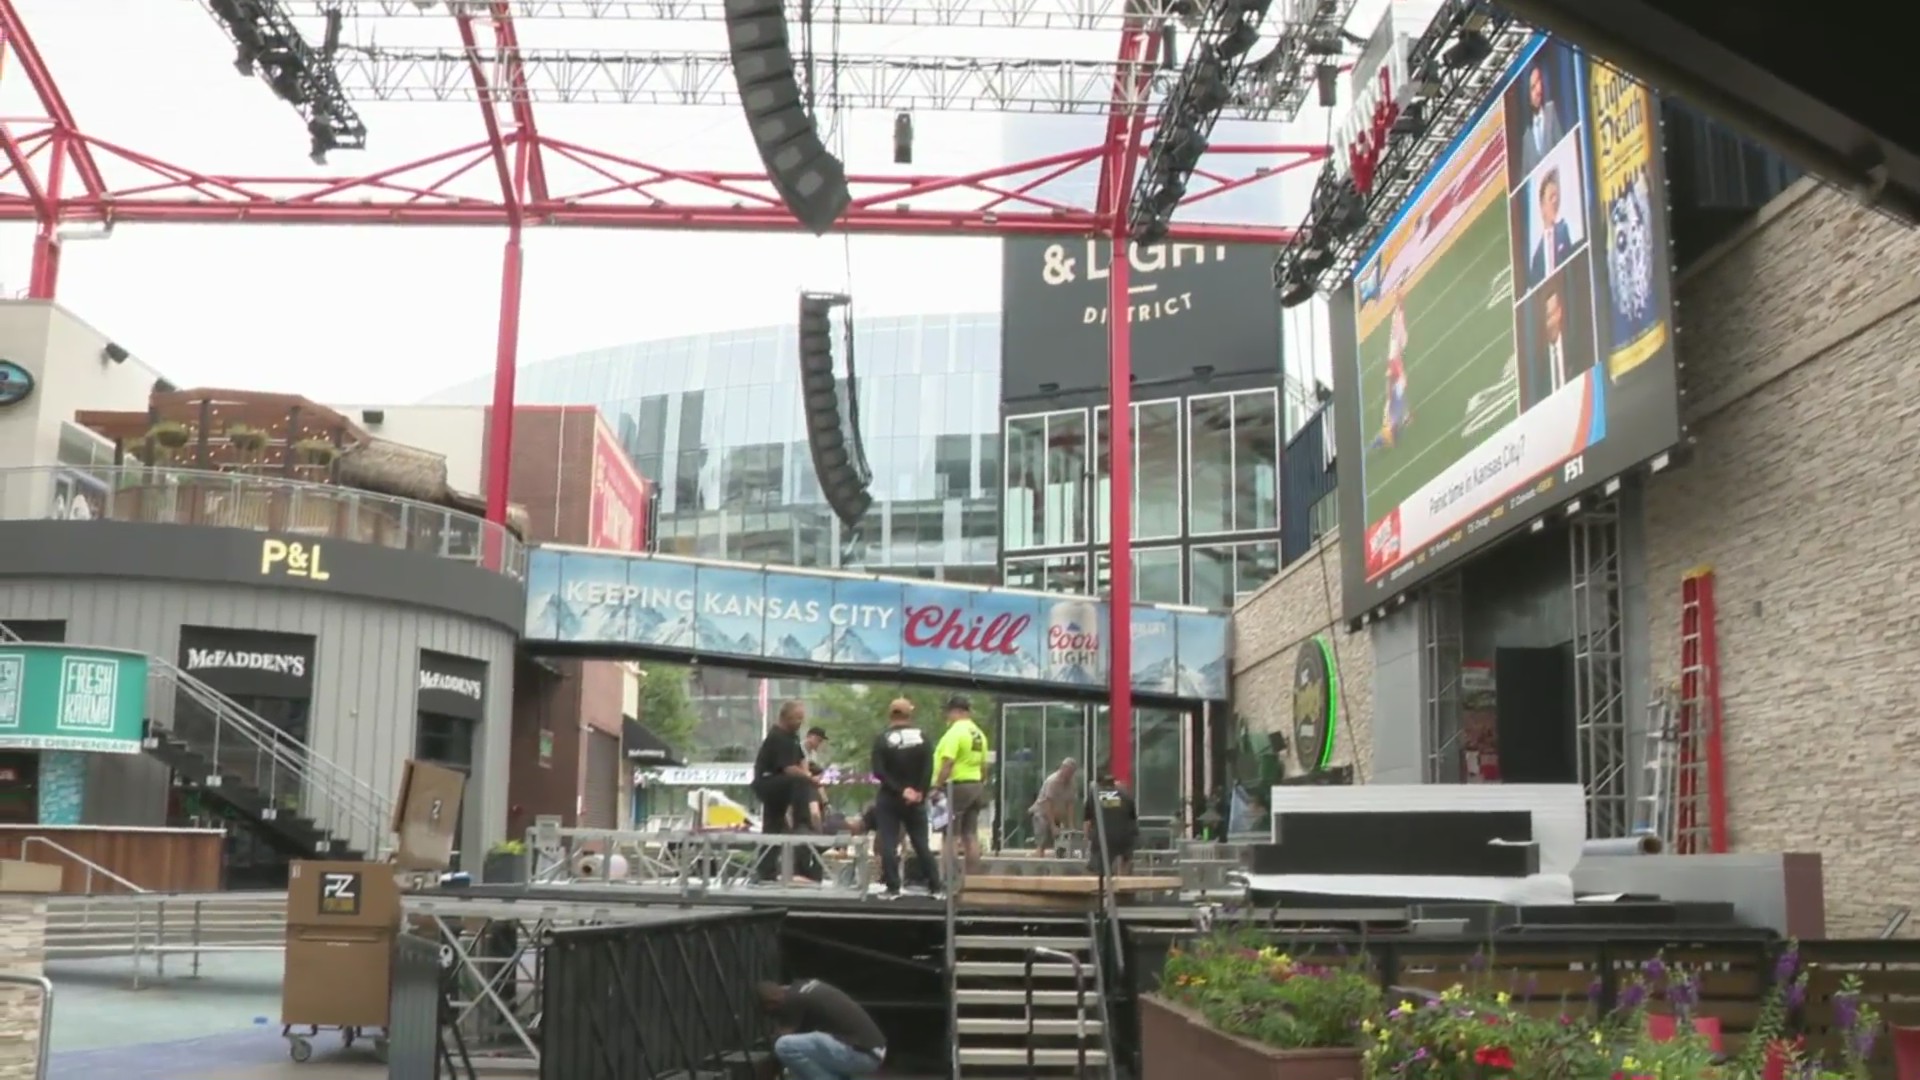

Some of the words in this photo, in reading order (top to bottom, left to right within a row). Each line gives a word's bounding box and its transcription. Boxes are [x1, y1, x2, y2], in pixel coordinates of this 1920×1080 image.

[1599, 100, 1643, 156] Death
[1042, 243, 1076, 286] &
[1083, 291, 1193, 325] DITRICT
[1473, 453, 1502, 490] Kansas
[1564, 455, 1584, 483] FS1
[261, 538, 330, 581] P&L
[566, 579, 693, 612] KEEPING
[704, 592, 820, 624] KANSAS
[829, 602, 894, 630] CITY
[904, 604, 1031, 656] Chill
[1048, 624, 1100, 652] Coors
[1050, 650, 1098, 666] LIGHT
[66, 662, 114, 697] FRESH
[63, 692, 111, 727] KARMA
